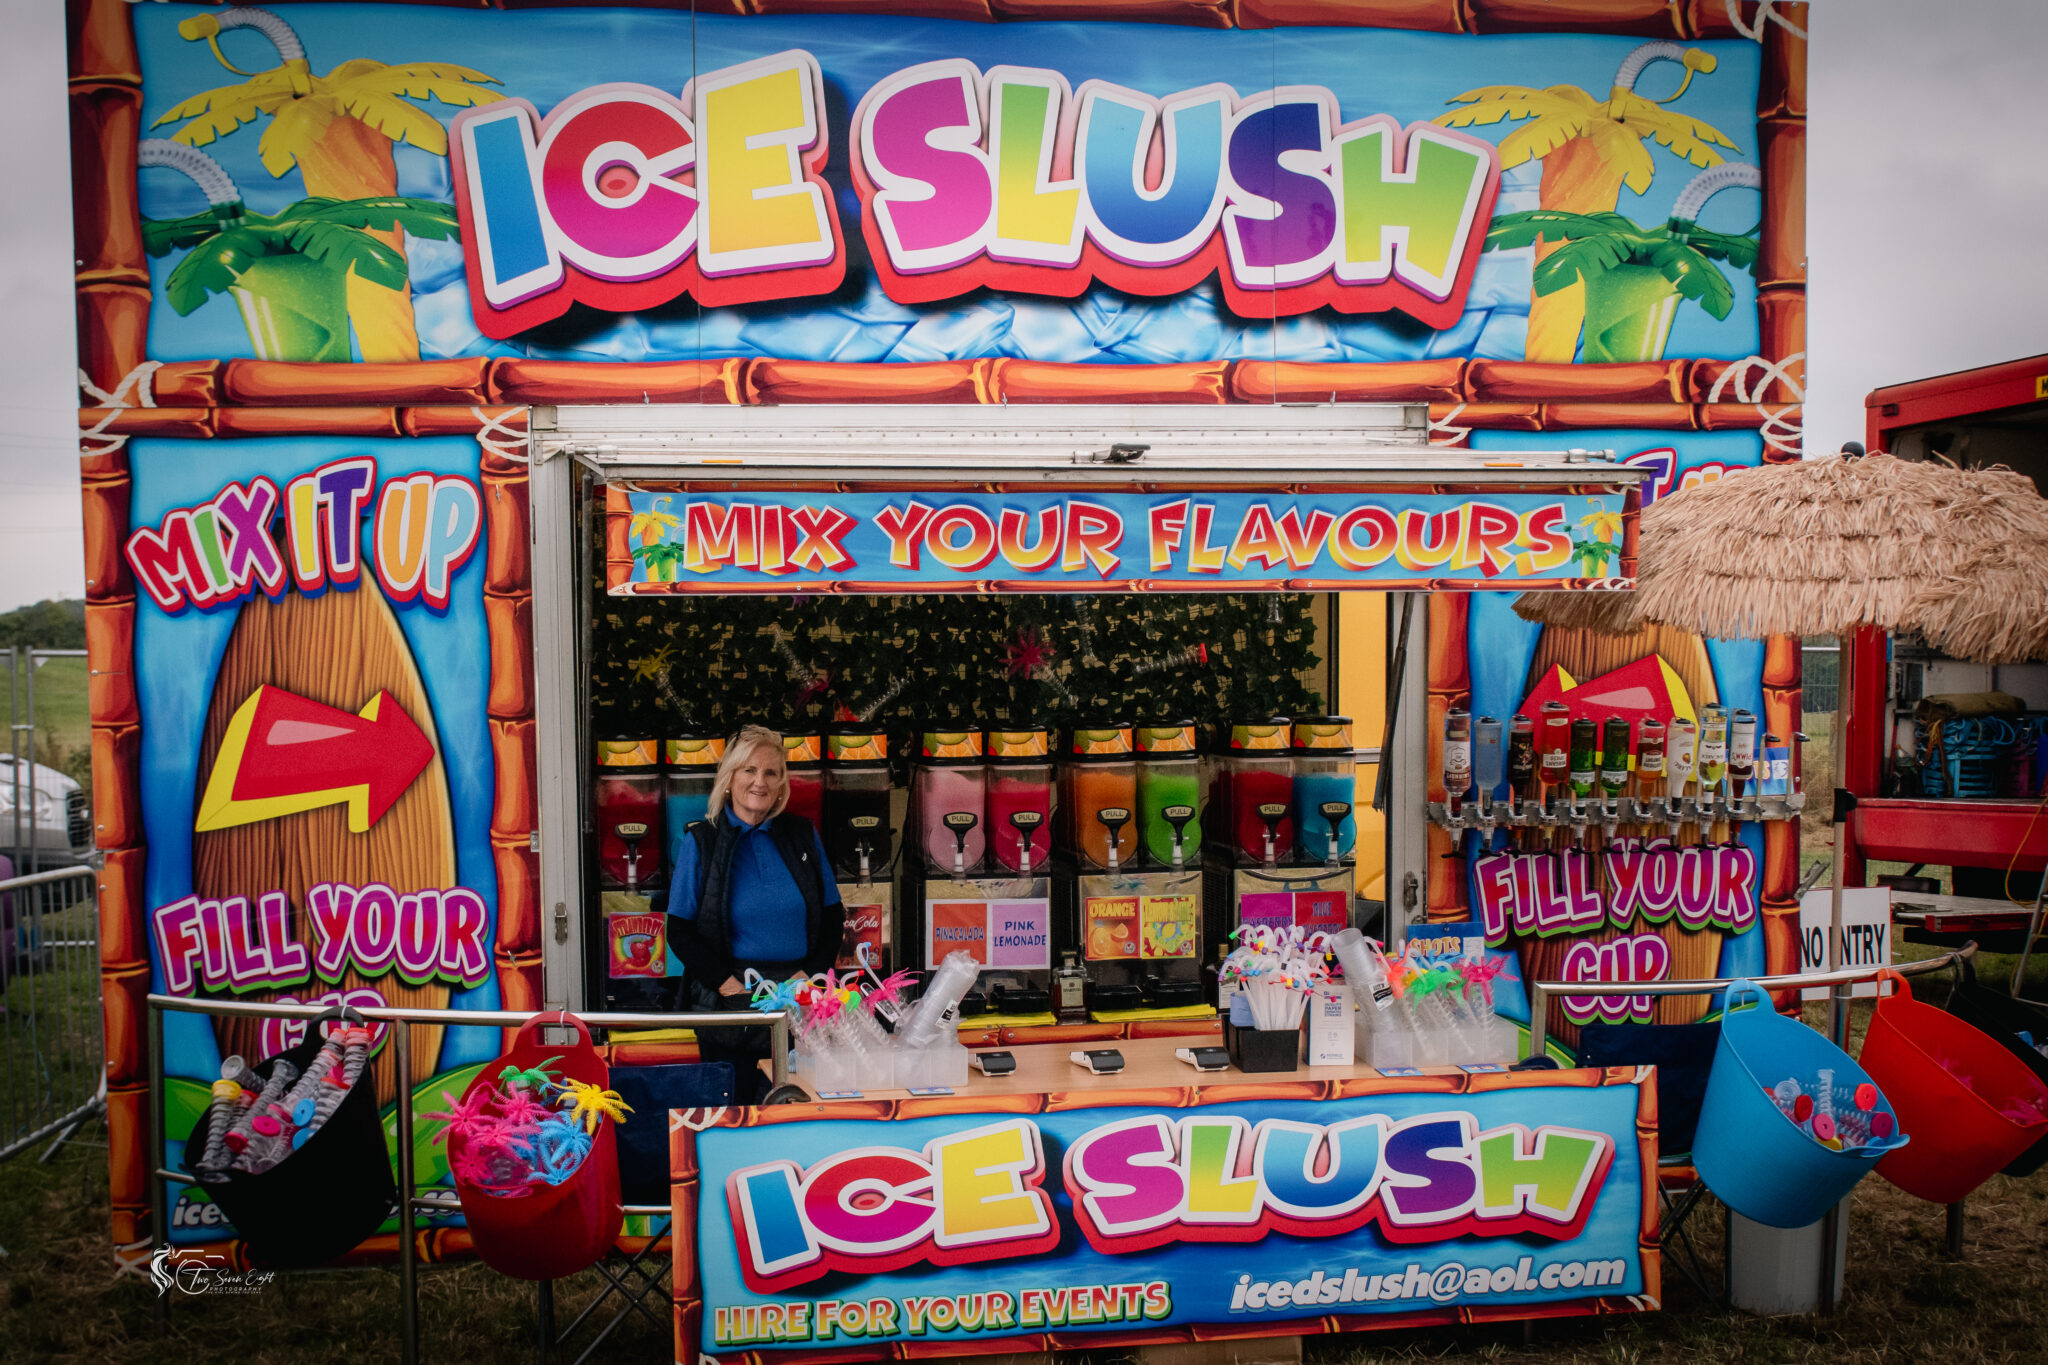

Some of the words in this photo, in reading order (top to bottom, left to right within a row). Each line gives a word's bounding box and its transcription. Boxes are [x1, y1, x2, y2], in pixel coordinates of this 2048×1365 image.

[455, 49, 841, 320] ICE
[855, 62, 1495, 312] SLUSH
[125, 477, 285, 609] MIX
[286, 458, 375, 588] IT
[375, 473, 482, 606] UP
[684, 501, 854, 571] MIX
[873, 500, 1123, 577] YOUR
[1149, 499, 1574, 576] FLAVOURS
[623, 824, 642, 832] PULL
[1089, 902, 1136, 918] ORANGE
[1312, 902, 1331, 916] BLUE
[1474, 848, 1604, 939] FILL
[1605, 837, 1757, 926] YOUR
[153, 888, 309, 995] FILL
[308, 882, 489, 981] YOUR
[935, 926, 984, 942] PINACALADA
[994, 934, 1047, 947] LEMONADE
[1004, 920, 1035, 931] PINK
[1411, 937, 1461, 957] SHOTS
[1800, 926, 1823, 968] NO
[1829, 924, 1885, 967] NTRY
[1560, 932, 1670, 1018] CUP
[731, 1118, 1056, 1282] ICE
[1066, 1110, 1609, 1241] SLUSH
[1229, 1256, 1627, 1310] icedslush@aol.com
[714, 1302, 813, 1344] HIRE
[815, 1297, 900, 1337] FOR
[902, 1289, 1015, 1333] YOUR
[1019, 1280, 1172, 1325] EVENTS
